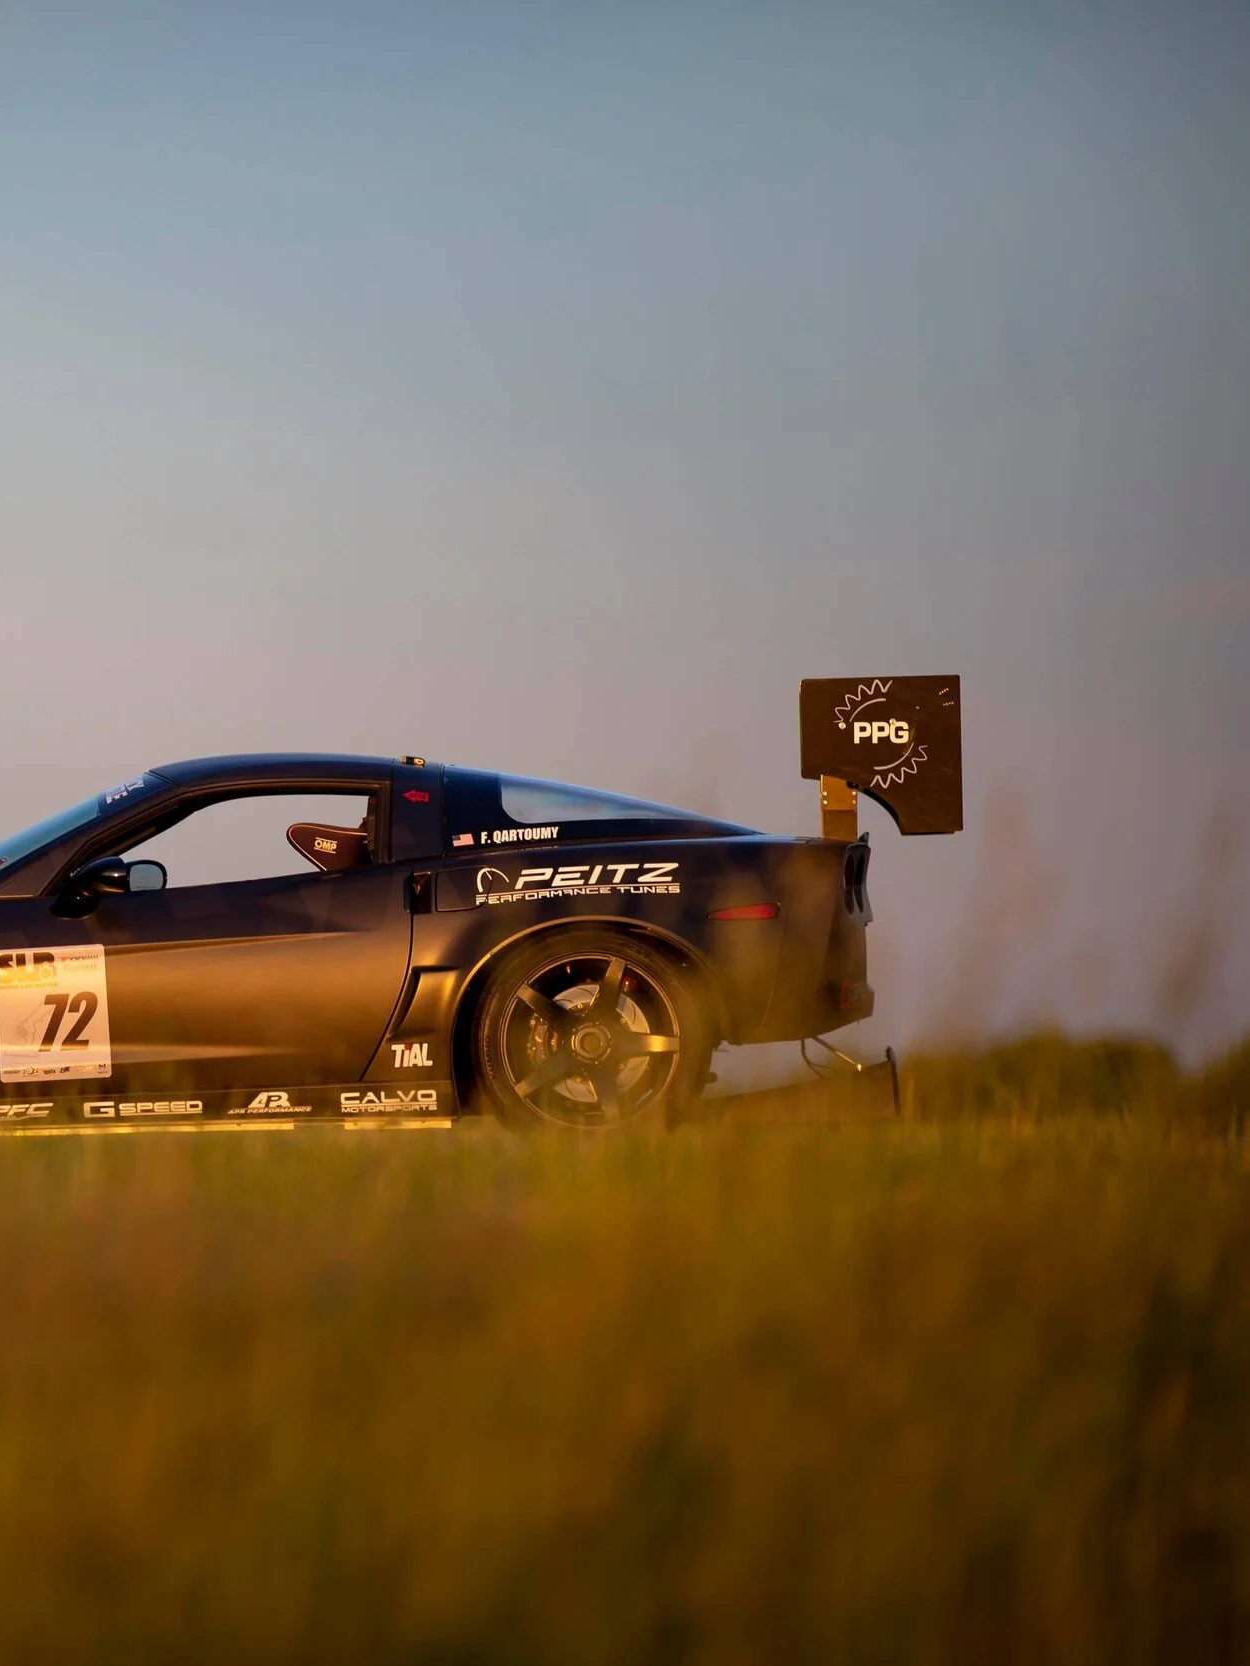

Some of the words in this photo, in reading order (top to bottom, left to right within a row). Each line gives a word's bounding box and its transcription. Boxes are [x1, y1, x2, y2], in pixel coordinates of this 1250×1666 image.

[853, 721, 909, 744] PPG
[481, 832, 491, 844] F.
[493, 827, 559, 842] QARTOUMY
[314, 840, 337, 851] OMP
[515, 863, 679, 889] PEITZ
[476, 887, 611, 905] PERFORMANCE
[617, 885, 680, 895] TUNES
[38, 991, 99, 1053] 72
[340, 1089, 437, 1104] CALVO
[83, 1101, 115, 1118] G
[119, 1101, 203, 1114] SPEED
[247, 1106, 312, 1114] PERFORMANCE
[341, 1104, 438, 1113] MOTORSPORTS
